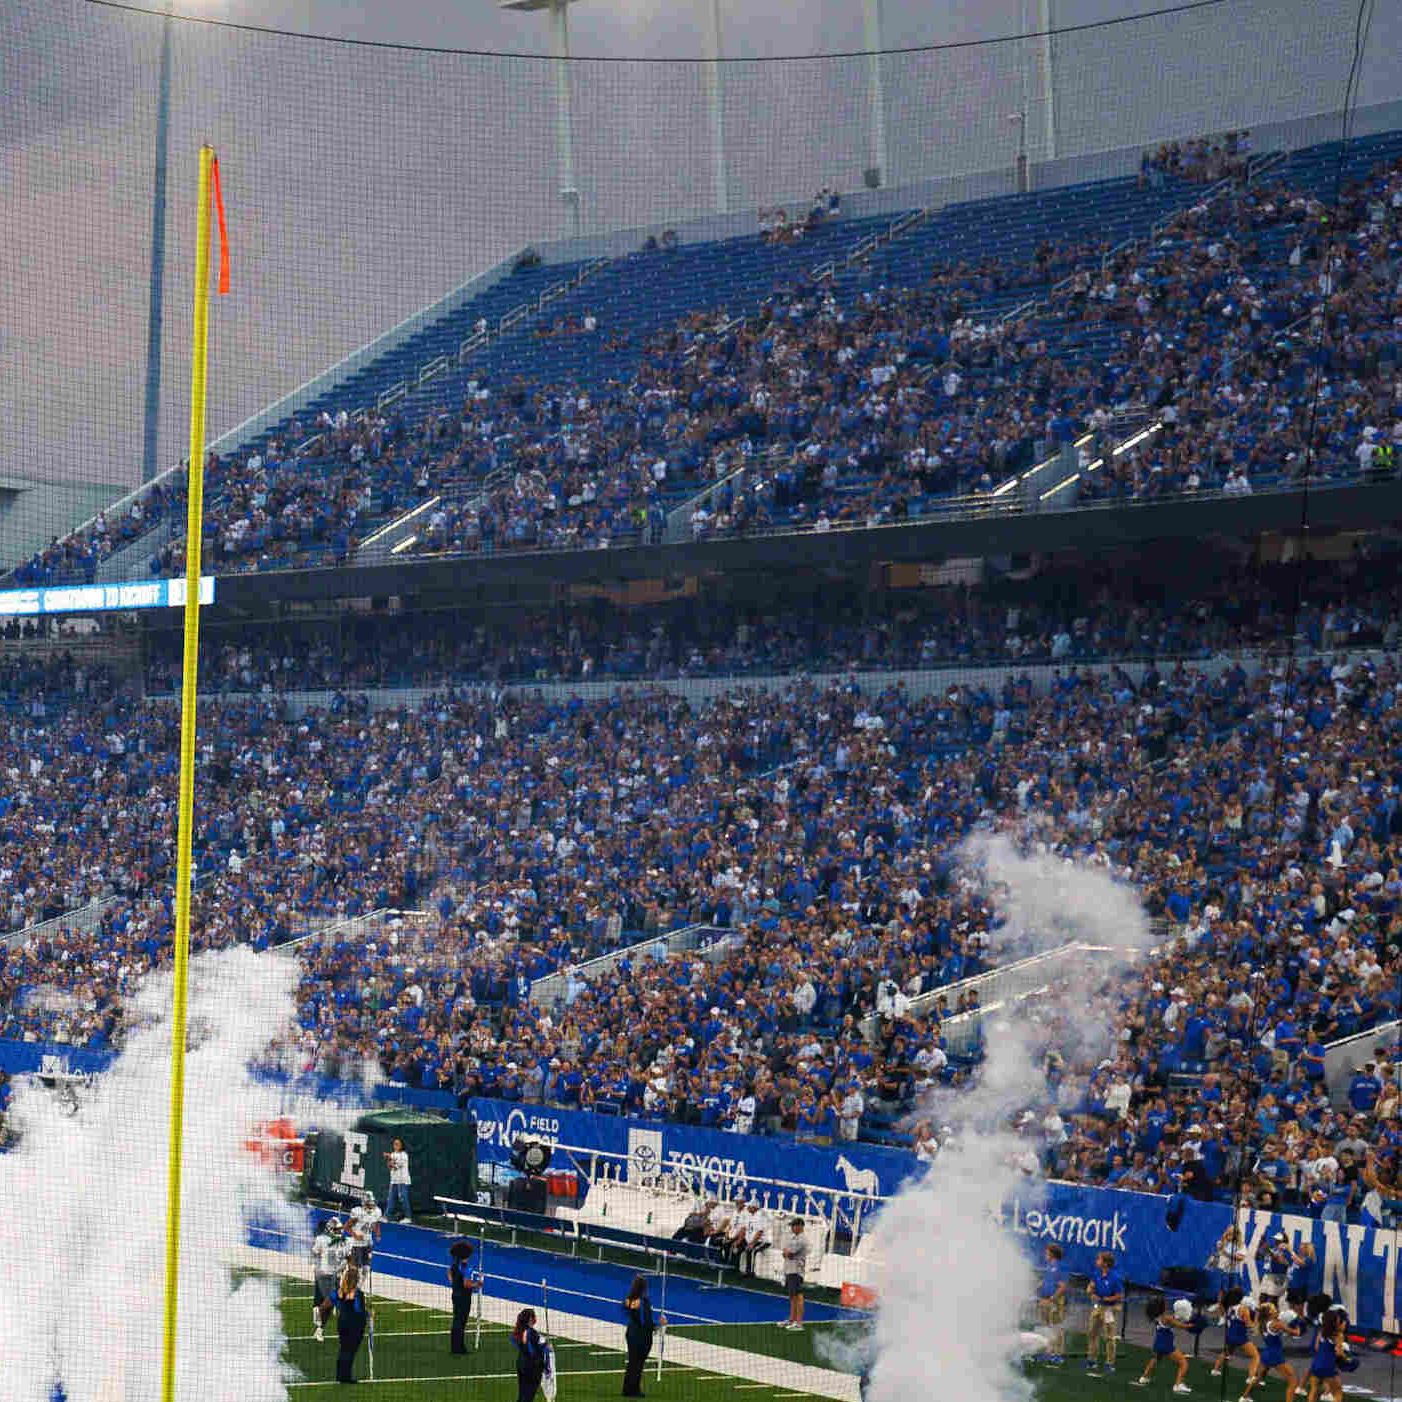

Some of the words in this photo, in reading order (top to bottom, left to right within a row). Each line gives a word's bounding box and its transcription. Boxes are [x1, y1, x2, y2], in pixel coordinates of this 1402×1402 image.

[530, 1117, 560, 1133] FIELD
[340, 1132, 369, 1189] E
[668, 1151, 748, 1187] TOYOTA
[1012, 1201, 1126, 1252] Lexmark
